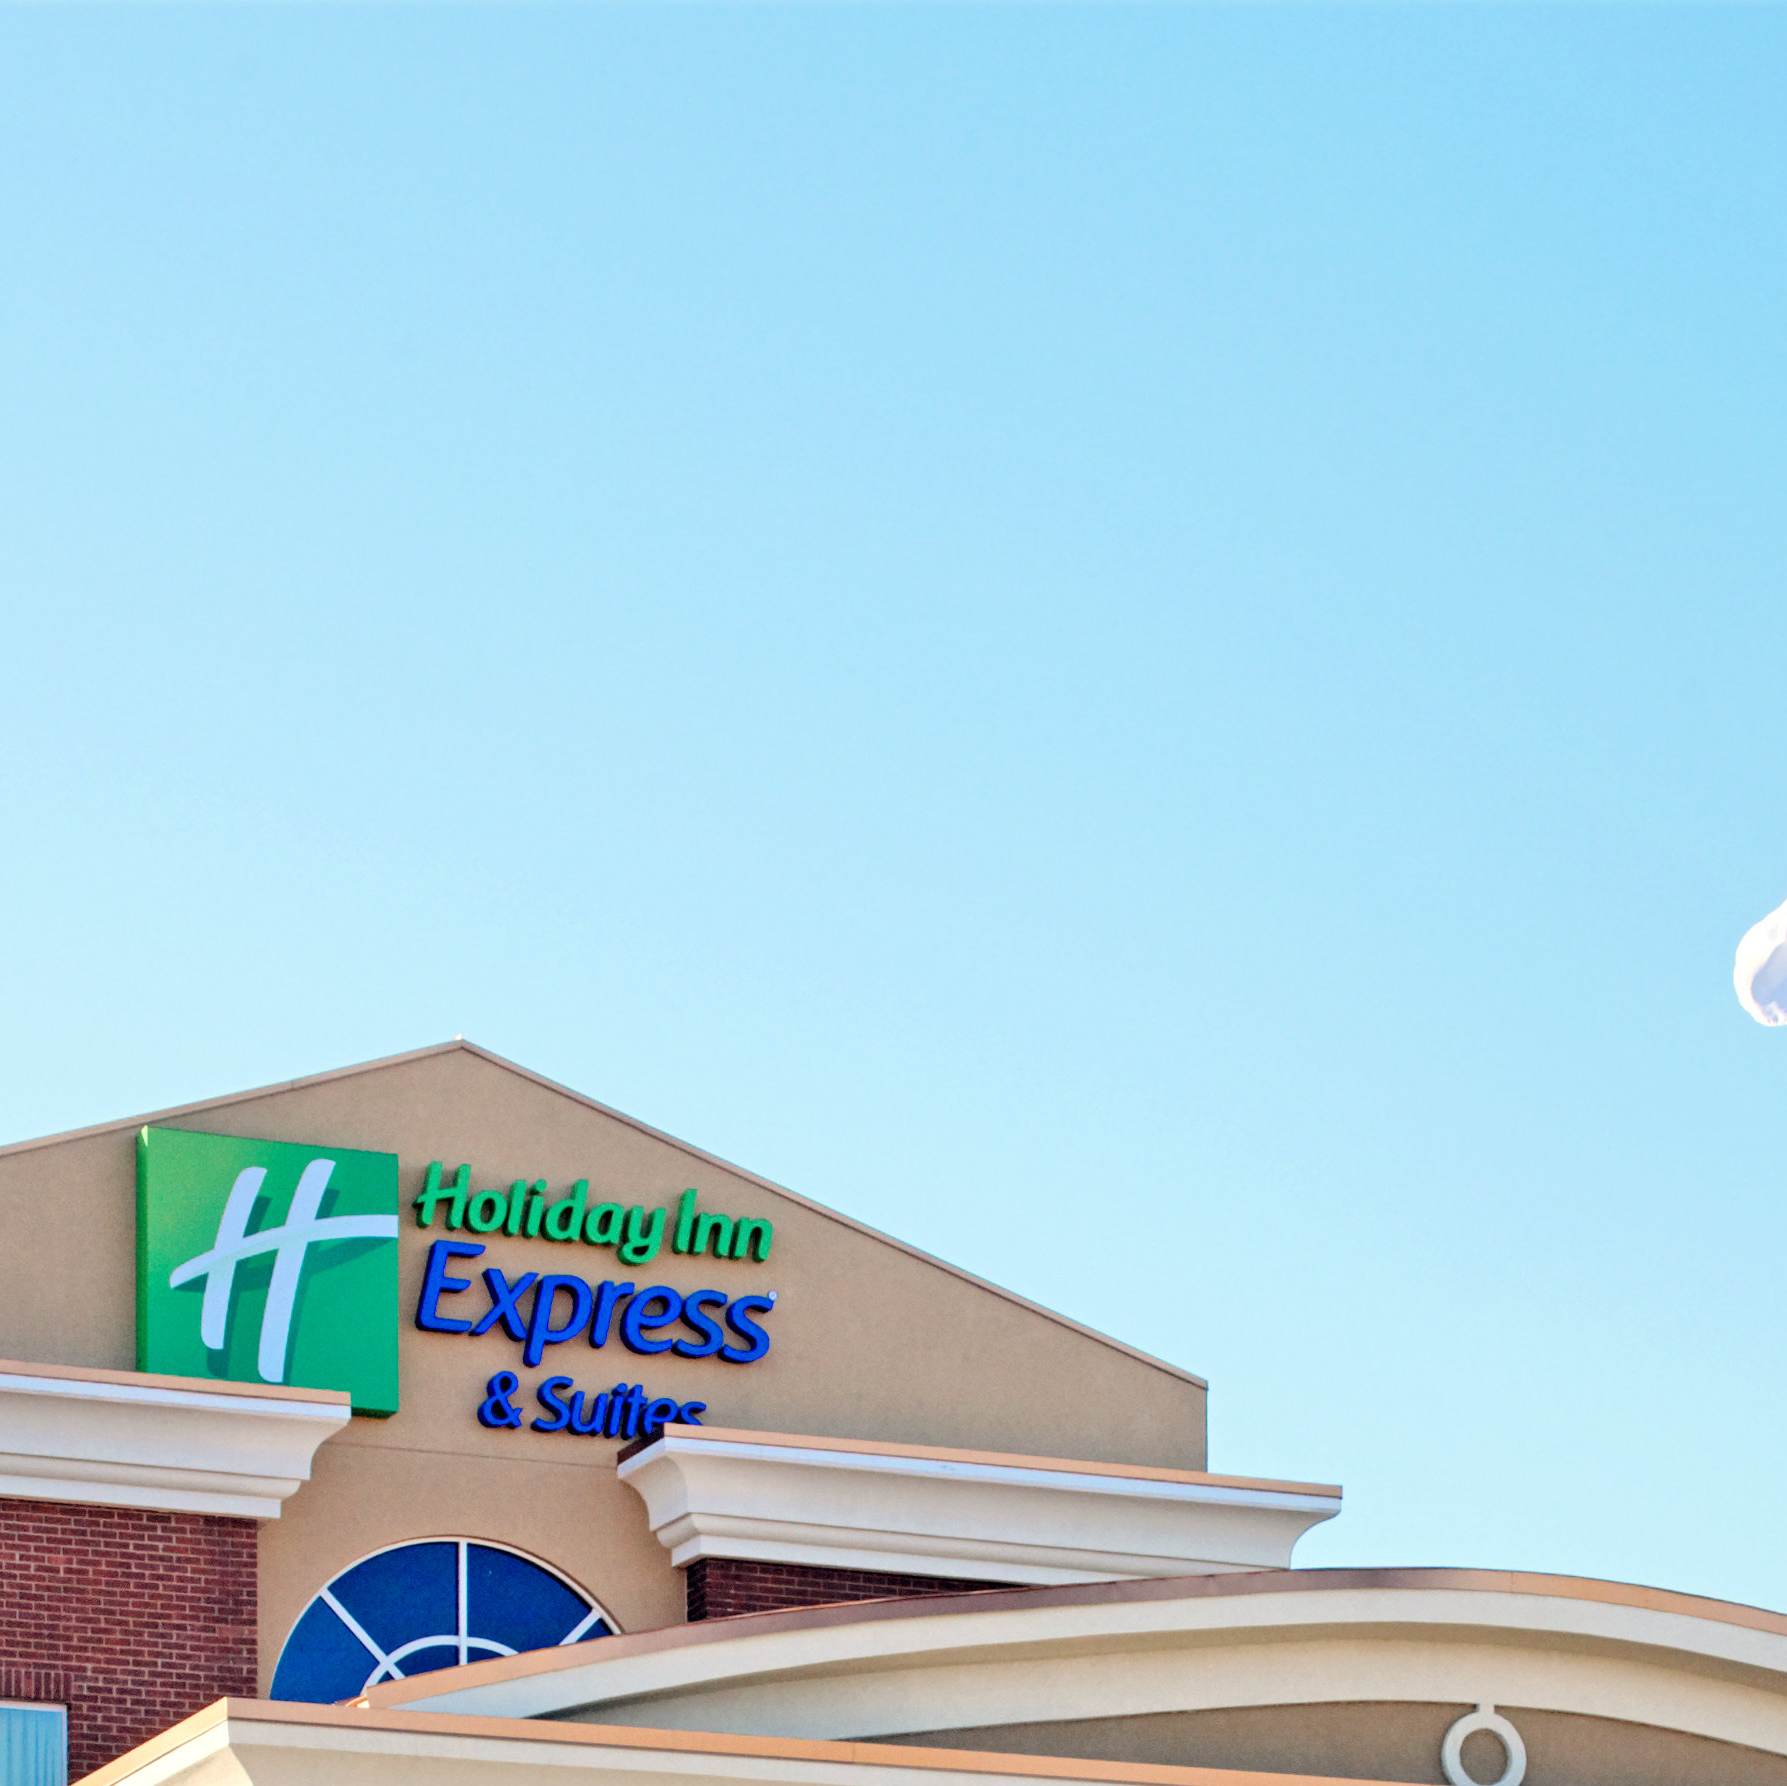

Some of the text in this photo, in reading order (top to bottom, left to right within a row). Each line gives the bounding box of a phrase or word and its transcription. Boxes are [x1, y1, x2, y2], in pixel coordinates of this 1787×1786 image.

[413, 1161, 773, 1266] Holiday Inn
[415, 1240, 776, 1368] Express
[477, 1370, 523, 1429] &
